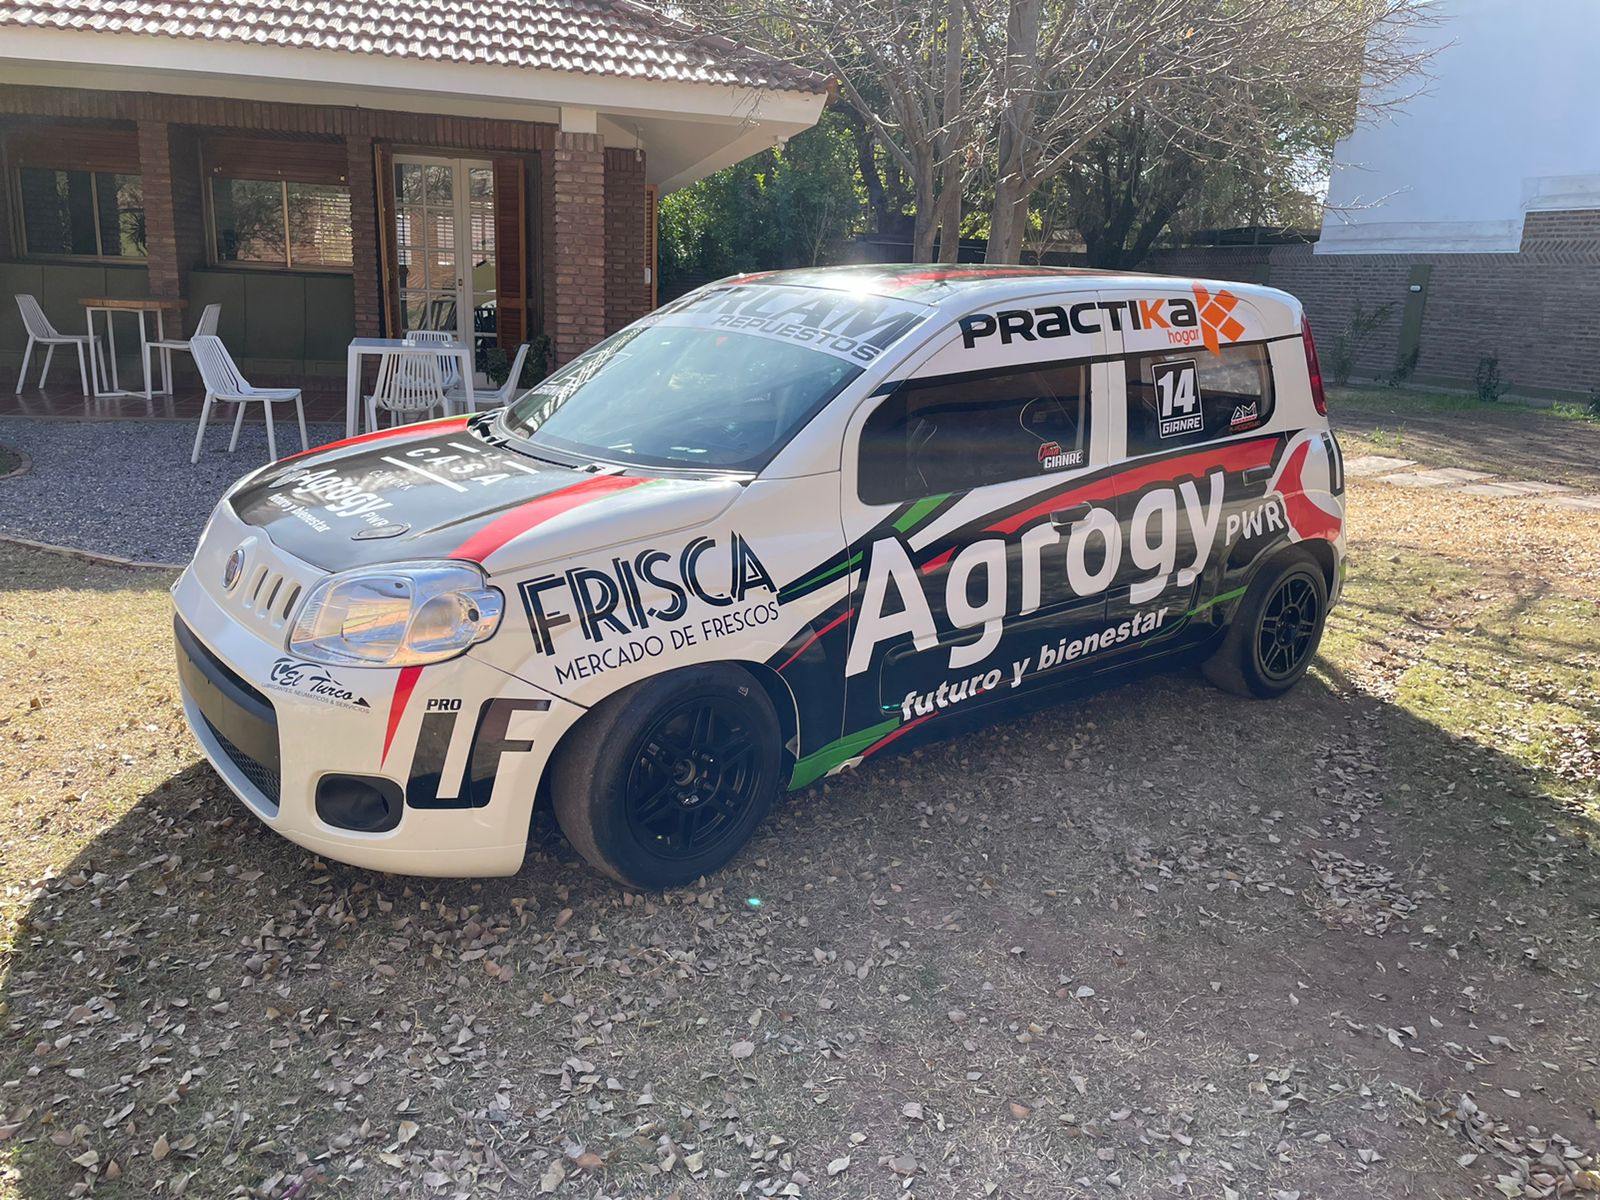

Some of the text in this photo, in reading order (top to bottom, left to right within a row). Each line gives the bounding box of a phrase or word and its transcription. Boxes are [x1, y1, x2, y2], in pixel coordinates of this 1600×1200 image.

[712, 315, 881, 362] REPUESTOS
[1167, 329, 1199, 345] hogar
[1158, 368, 1196, 417] 14
[1162, 417, 1201, 434] GIANRE
[406, 447, 510, 486] CASA
[1044, 451, 1083, 468] GIANRE
[292, 469, 393, 527] Agrogy PWR
[517, 530, 778, 656] FRISCA
[845, 472, 1285, 678] Agrogy PWR
[554, 601, 779, 684] MERCADO DE FRESCOS
[901, 606, 1169, 722] futuro y bienestar
[280, 670, 304, 686] El
[335, 701, 371, 714] SERVICIOS
[426, 698, 461, 711] PRO
